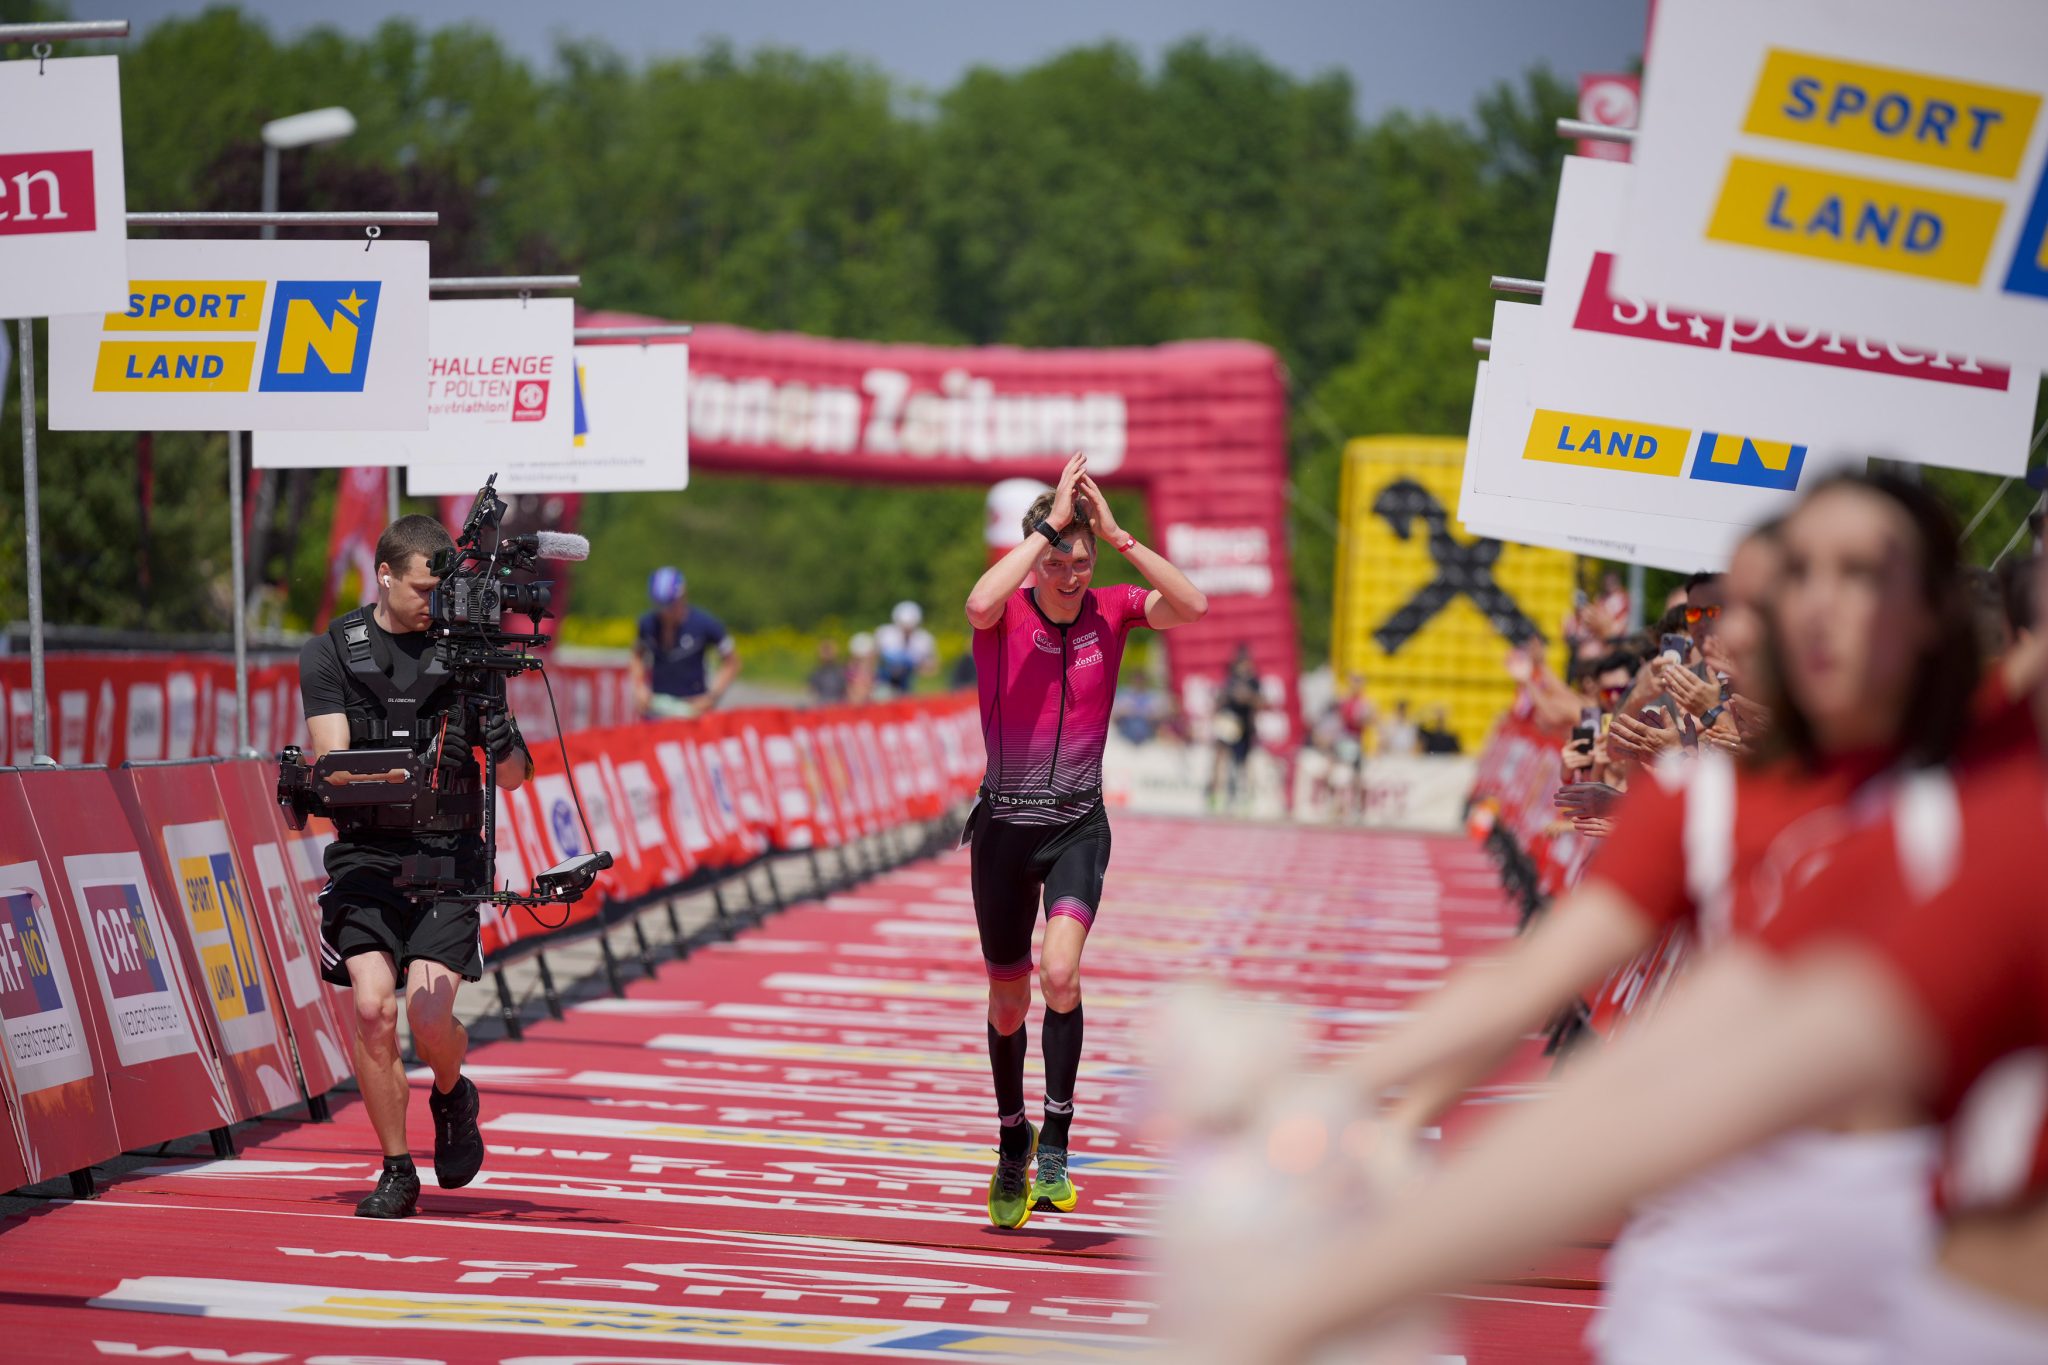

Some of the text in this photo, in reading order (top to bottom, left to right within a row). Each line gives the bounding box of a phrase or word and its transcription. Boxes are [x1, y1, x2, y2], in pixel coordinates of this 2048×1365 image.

[1782, 75, 2005, 153] SPORT
[0, 168, 68, 221] n
[1764, 184, 1946, 253] LAND
[124, 293, 246, 318] SPORT
[125, 354, 225, 379] LAND
[428, 355, 554, 376] HALLENGE
[1556, 425, 1659, 461] LAND
[186, 875, 215, 913] SPORT
[20, 916, 48, 977] NÖ
[96, 905, 156, 975] ORF NÖ
[209, 963, 236, 1001] LAND
